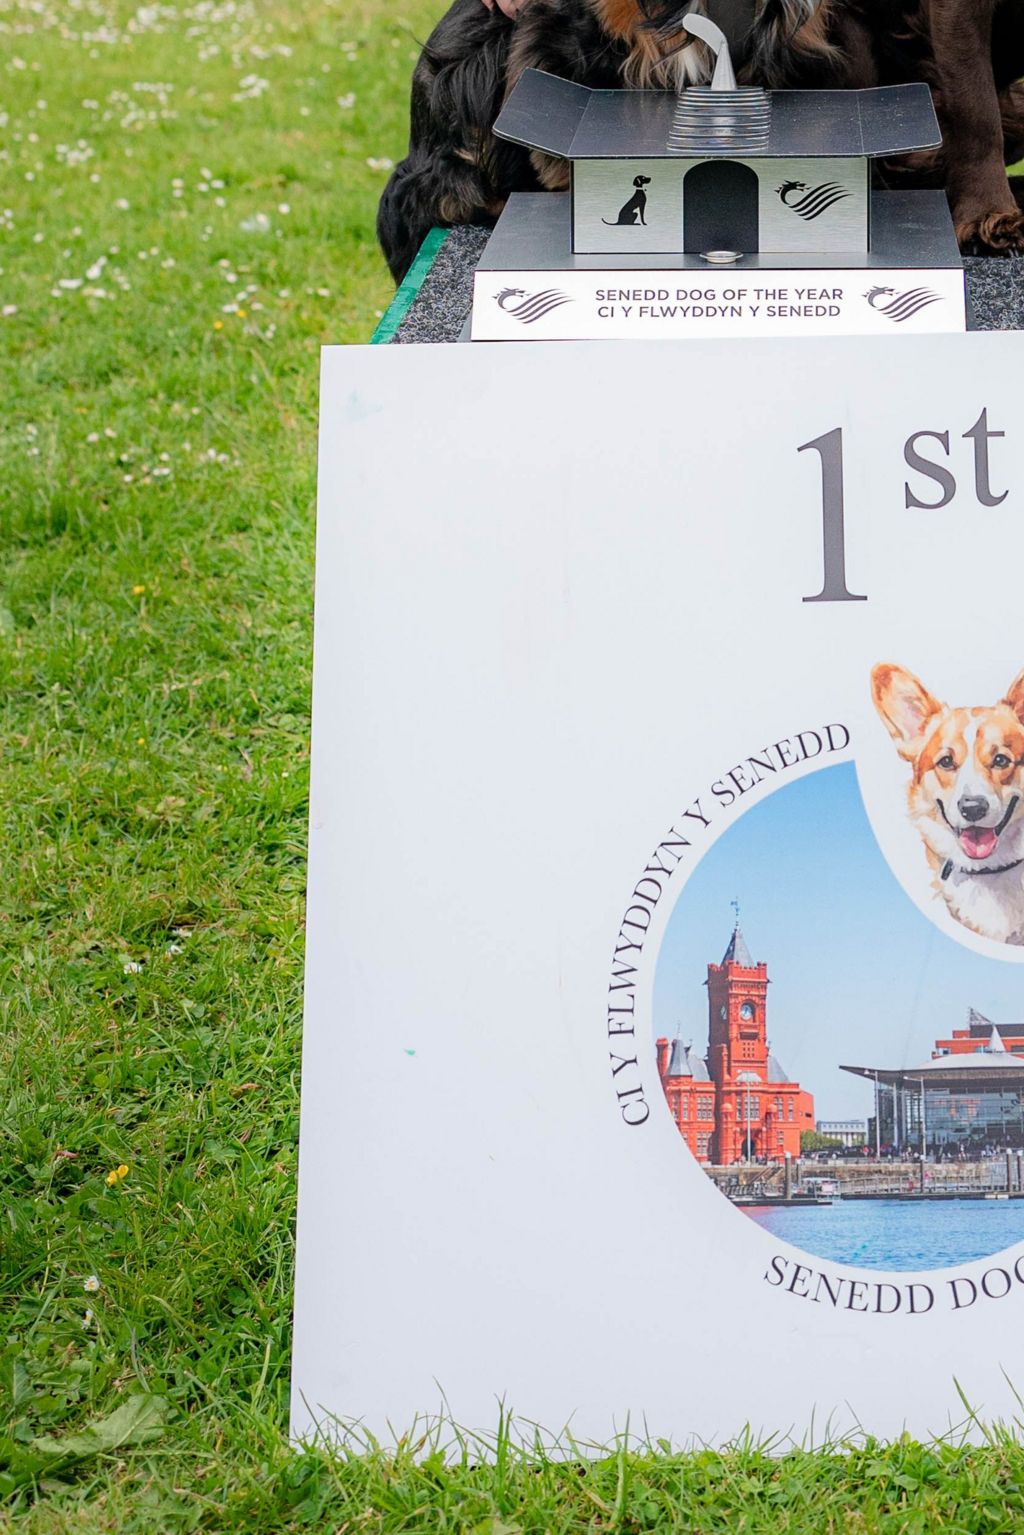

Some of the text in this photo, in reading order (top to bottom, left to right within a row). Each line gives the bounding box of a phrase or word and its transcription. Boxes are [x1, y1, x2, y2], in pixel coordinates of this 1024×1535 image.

[595, 288, 844, 301] SENEDD DOG OF THE YEAR
[597, 305, 841, 318] CI Y FLWYDDYN Y SENEDD
[607, 722, 851, 1126] CI Y FLWYDDYN Y SENEDD
[763, 1255, 935, 1315] SENEDD
